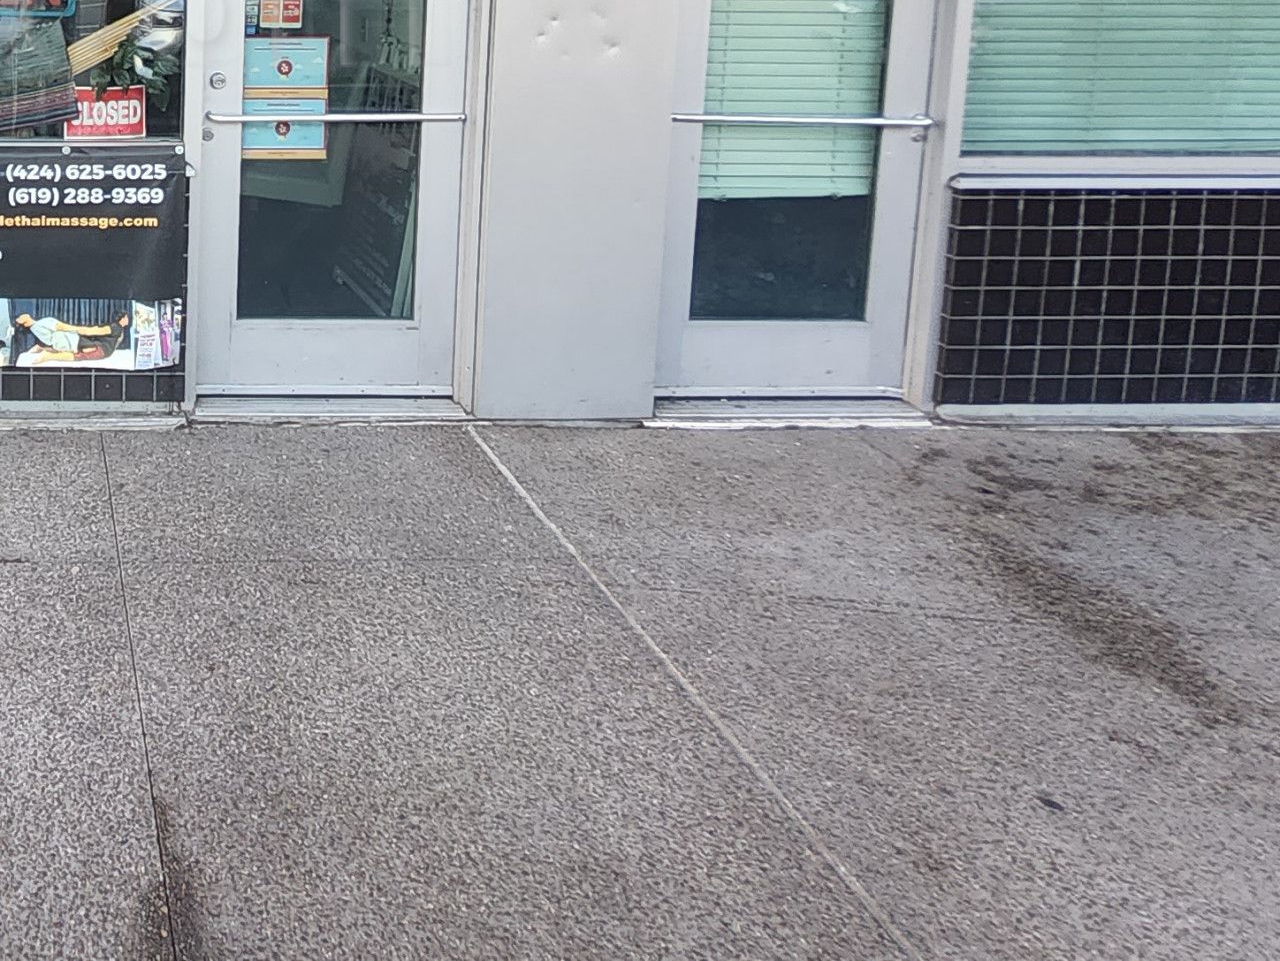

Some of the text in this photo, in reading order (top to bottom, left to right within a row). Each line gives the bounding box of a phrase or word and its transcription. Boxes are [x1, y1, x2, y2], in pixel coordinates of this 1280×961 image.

[5, 163, 167, 181] (424) 625-6025
[8, 187, 164, 206] (619) 288-9369
